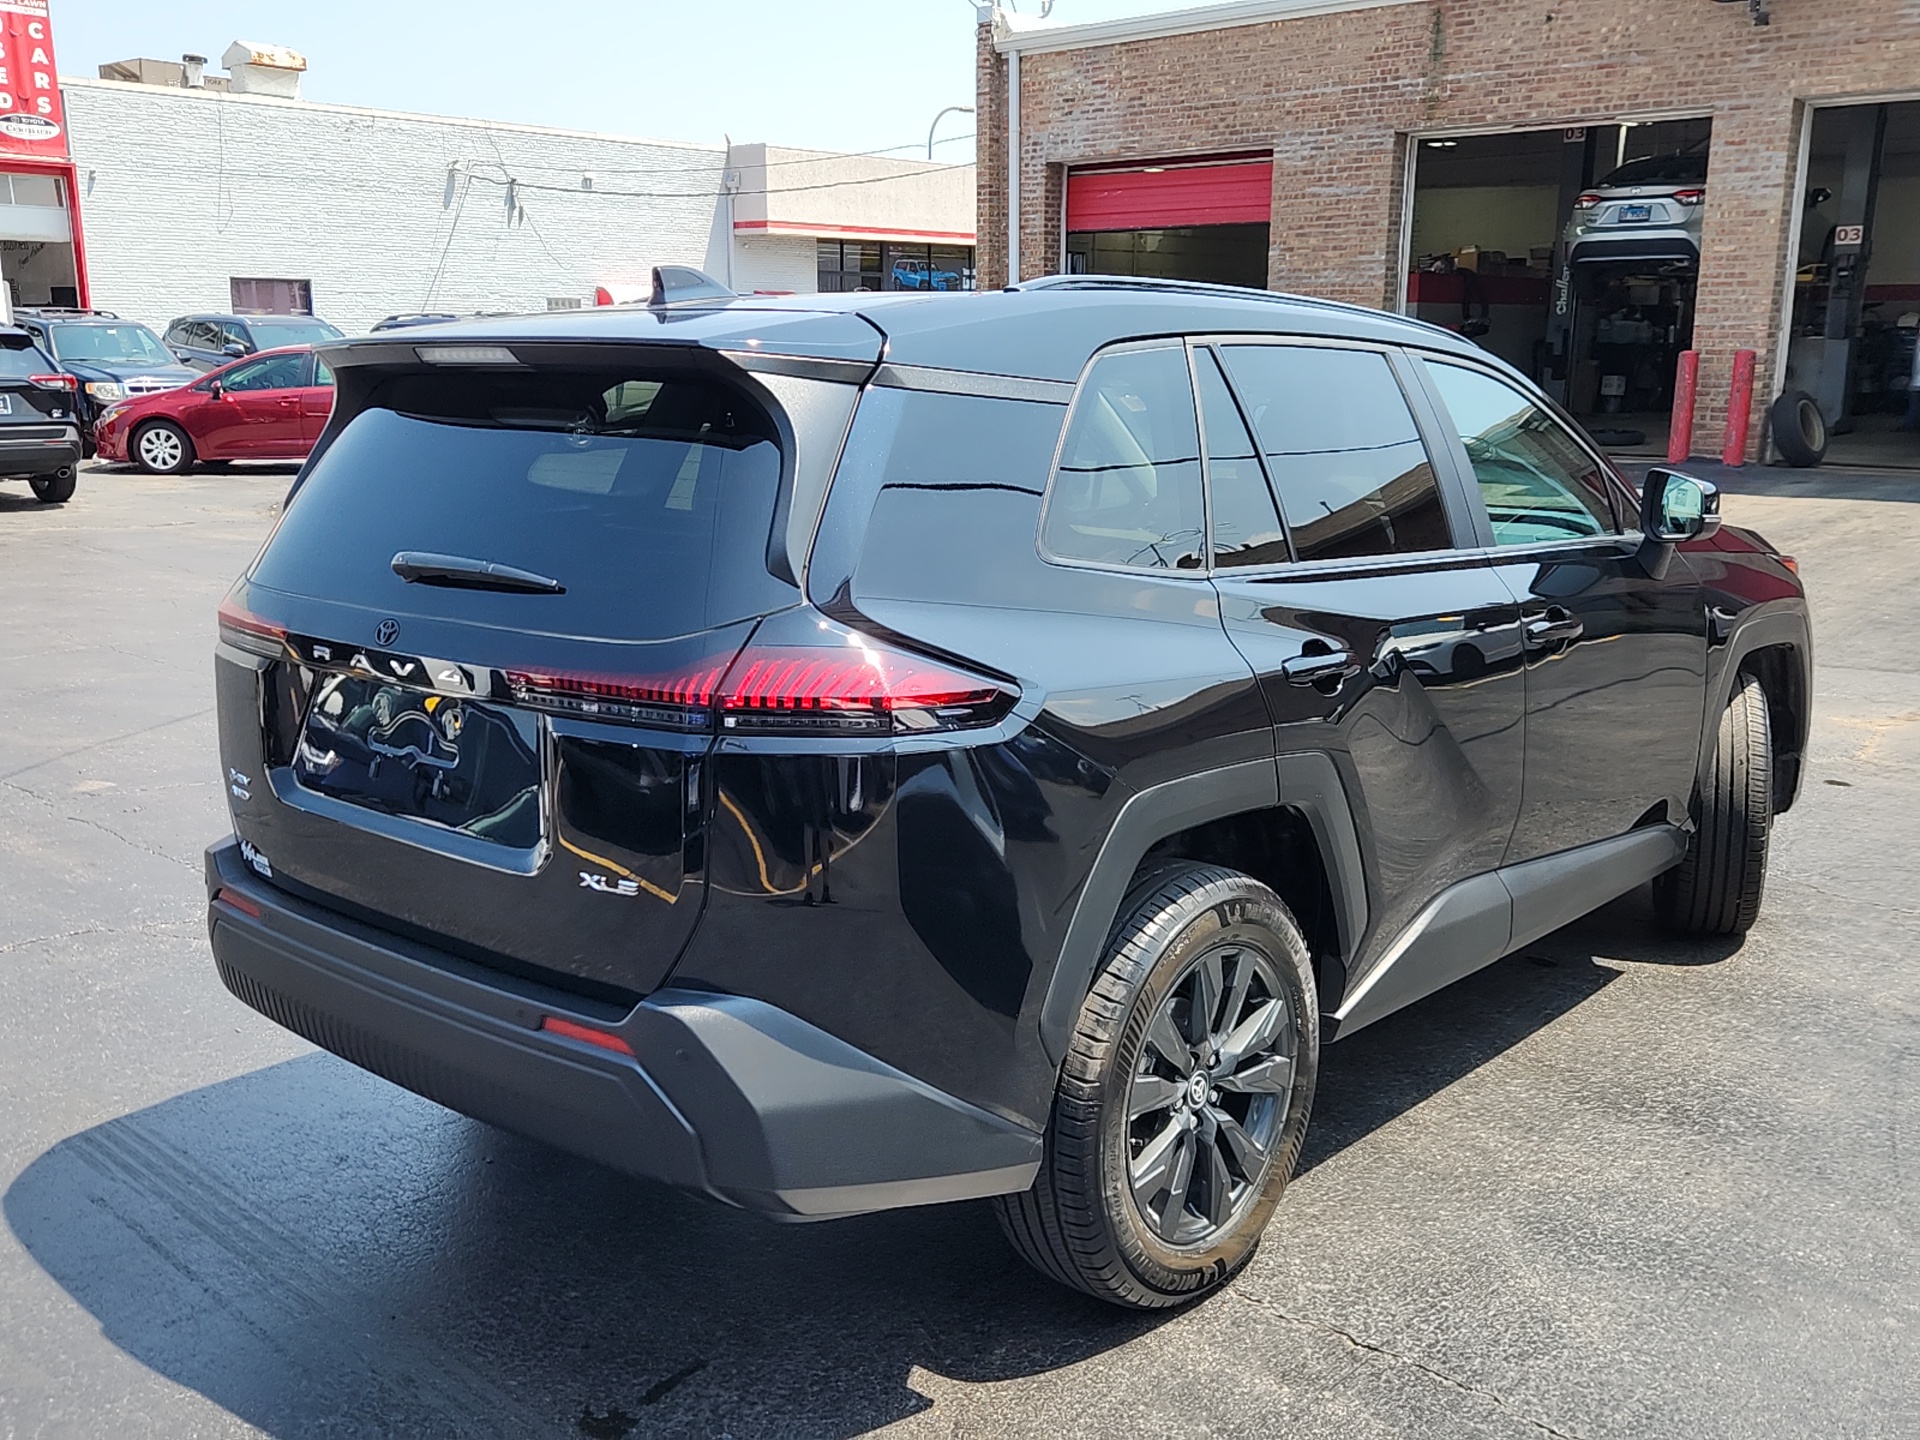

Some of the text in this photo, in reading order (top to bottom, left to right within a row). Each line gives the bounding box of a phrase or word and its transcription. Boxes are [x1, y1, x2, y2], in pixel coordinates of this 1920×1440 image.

[28, 21, 52, 114] CARS
[1565, 127, 1585, 140] 03
[1837, 228, 1861, 241] 03
[312, 645, 462, 685] RAV4
[579, 872, 639, 896] XLE
[1129, 1249, 1202, 1291] MICHELIN
